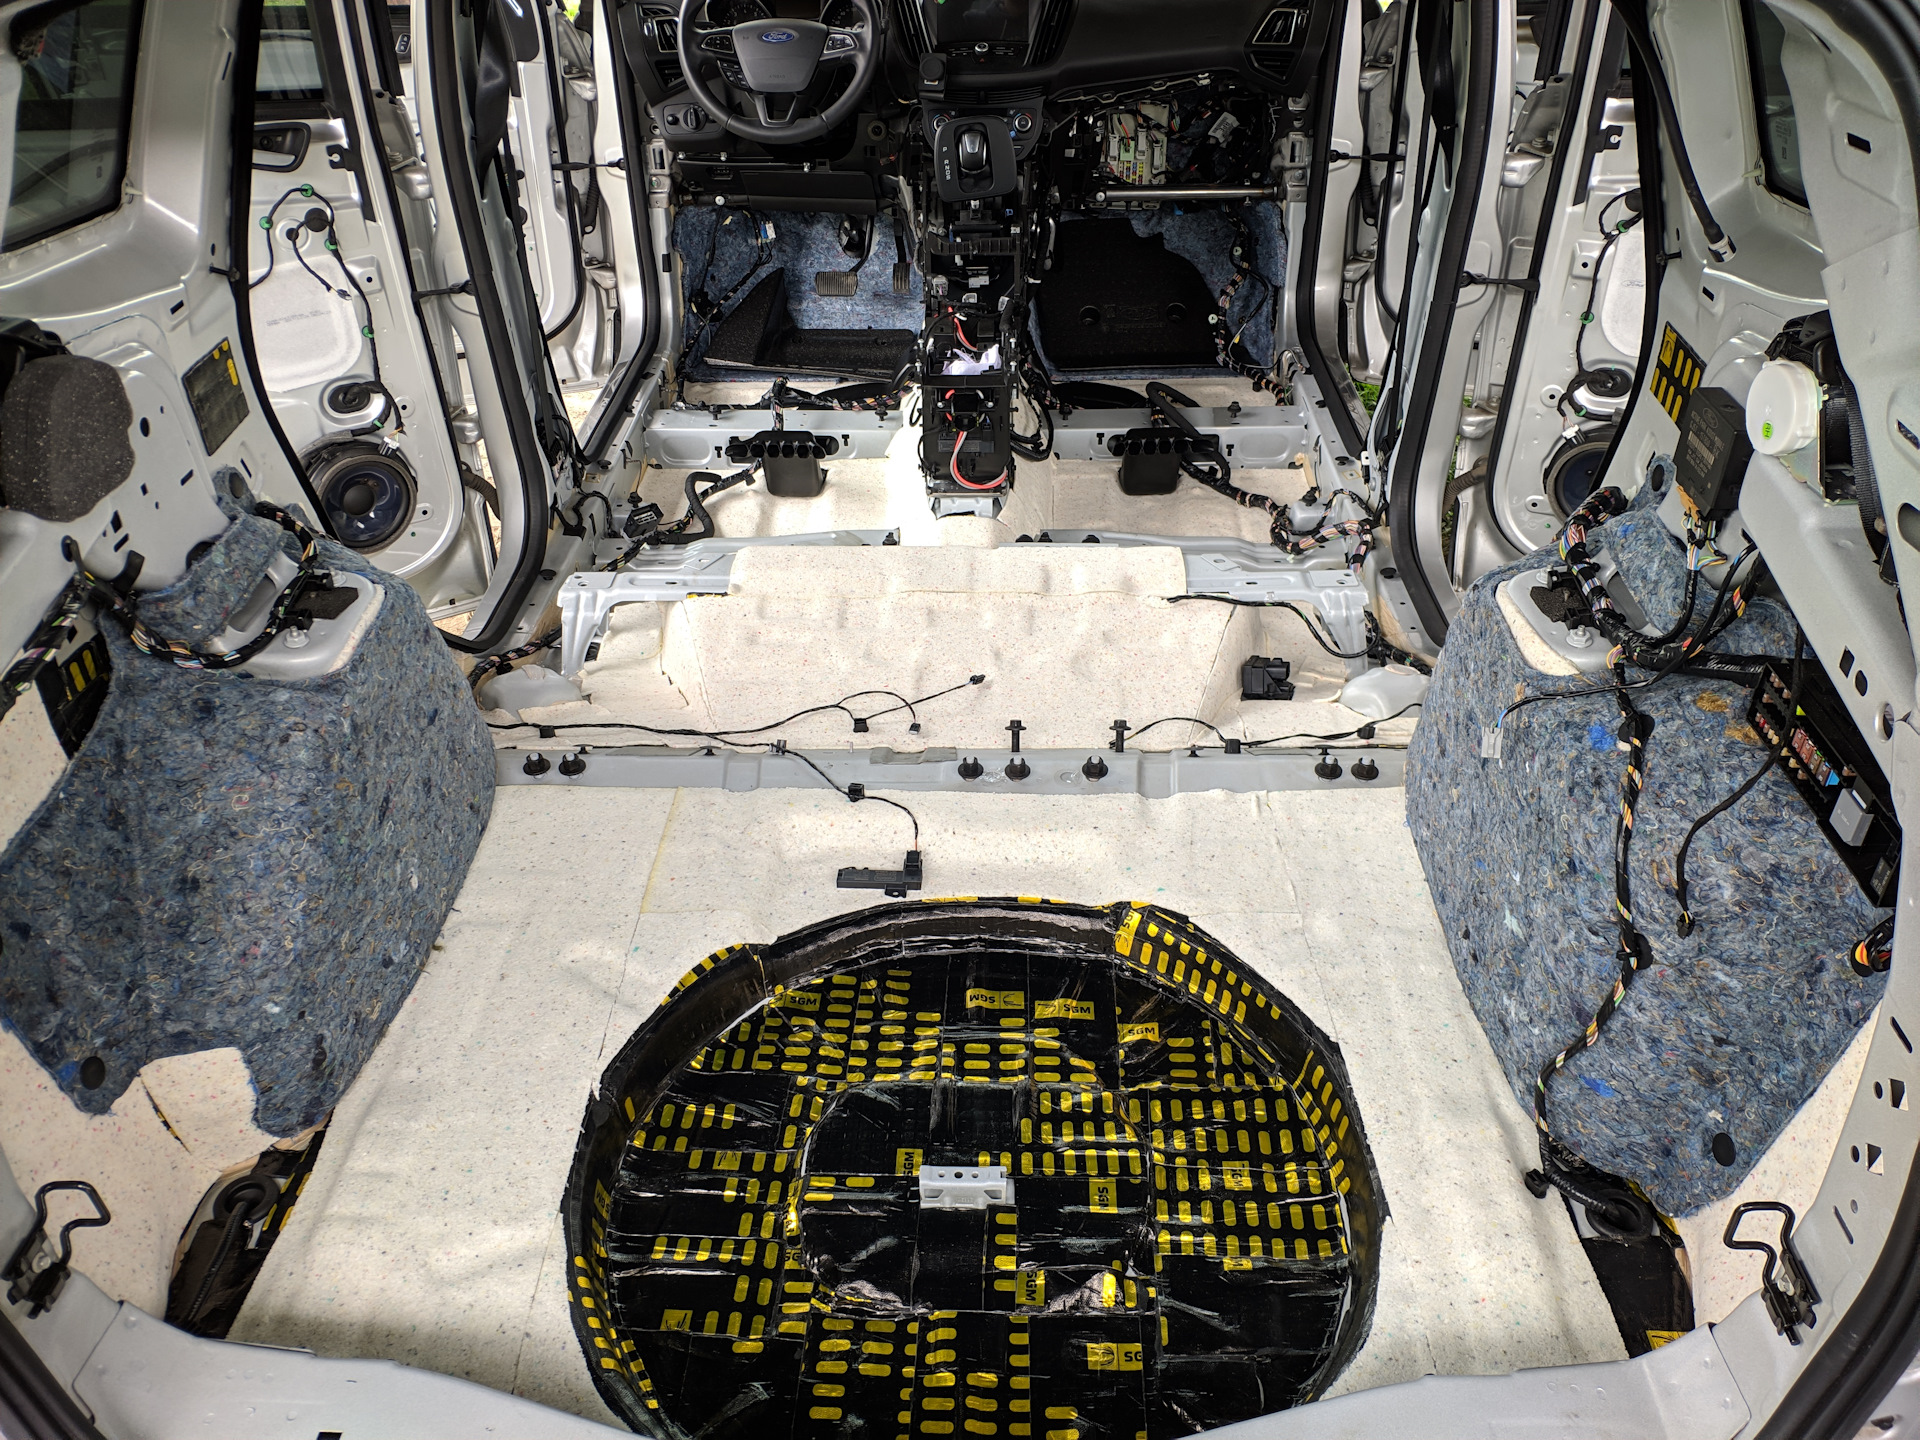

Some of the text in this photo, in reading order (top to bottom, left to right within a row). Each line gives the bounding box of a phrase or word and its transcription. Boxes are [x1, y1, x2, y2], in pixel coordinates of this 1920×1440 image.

[768, 31, 787, 40] Ford
[1764, 422, 1771, 438] RH
[790, 996, 817, 1005] SGM
[969, 994, 996, 1004] SGM
[1063, 1004, 1091, 1014] SGM
[1128, 1027, 1155, 1036] SGM
[904, 1151, 914, 1176] SGM
[1025, 1272, 1038, 1301] SGM
